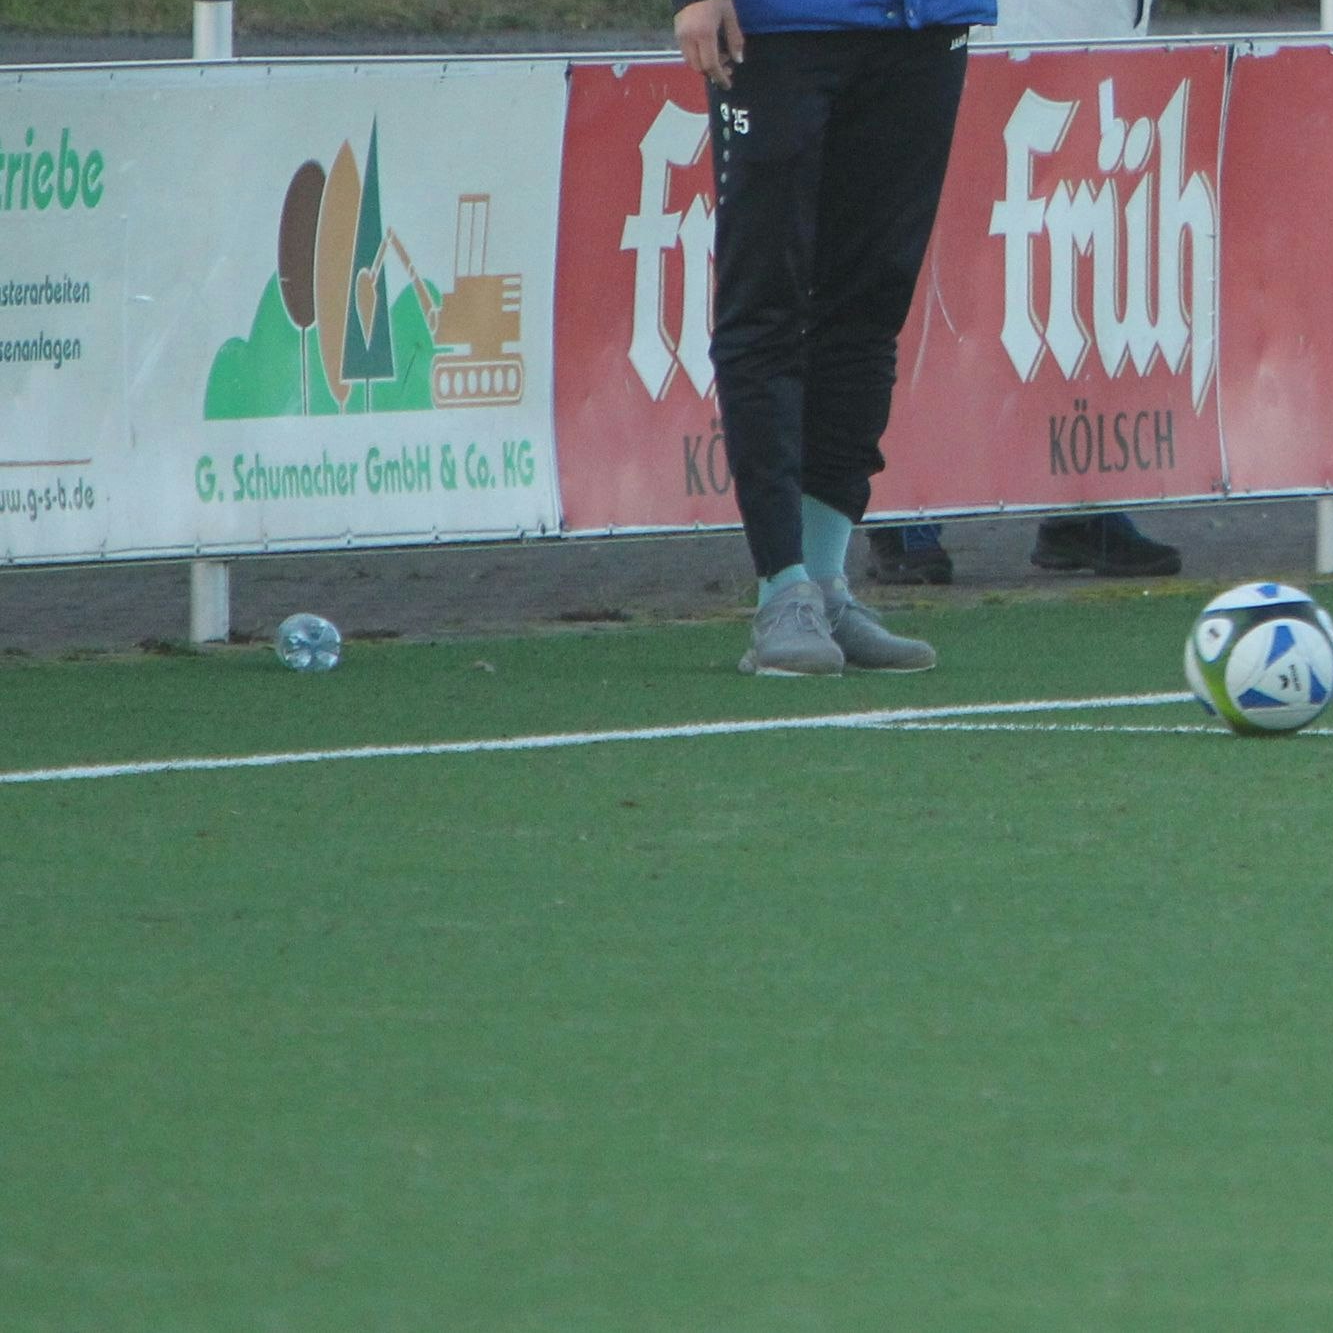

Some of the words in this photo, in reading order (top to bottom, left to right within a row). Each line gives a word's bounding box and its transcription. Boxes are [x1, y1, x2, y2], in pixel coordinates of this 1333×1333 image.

[0, 127, 104, 211] riebe
[232, 449, 358, 502] Schumacher
[366, 446, 432, 495] GmbH
[440, 443, 458, 491] &
[502, 439, 535, 488] KG
[1049, 398, 1175, 476] KÖLSCH
